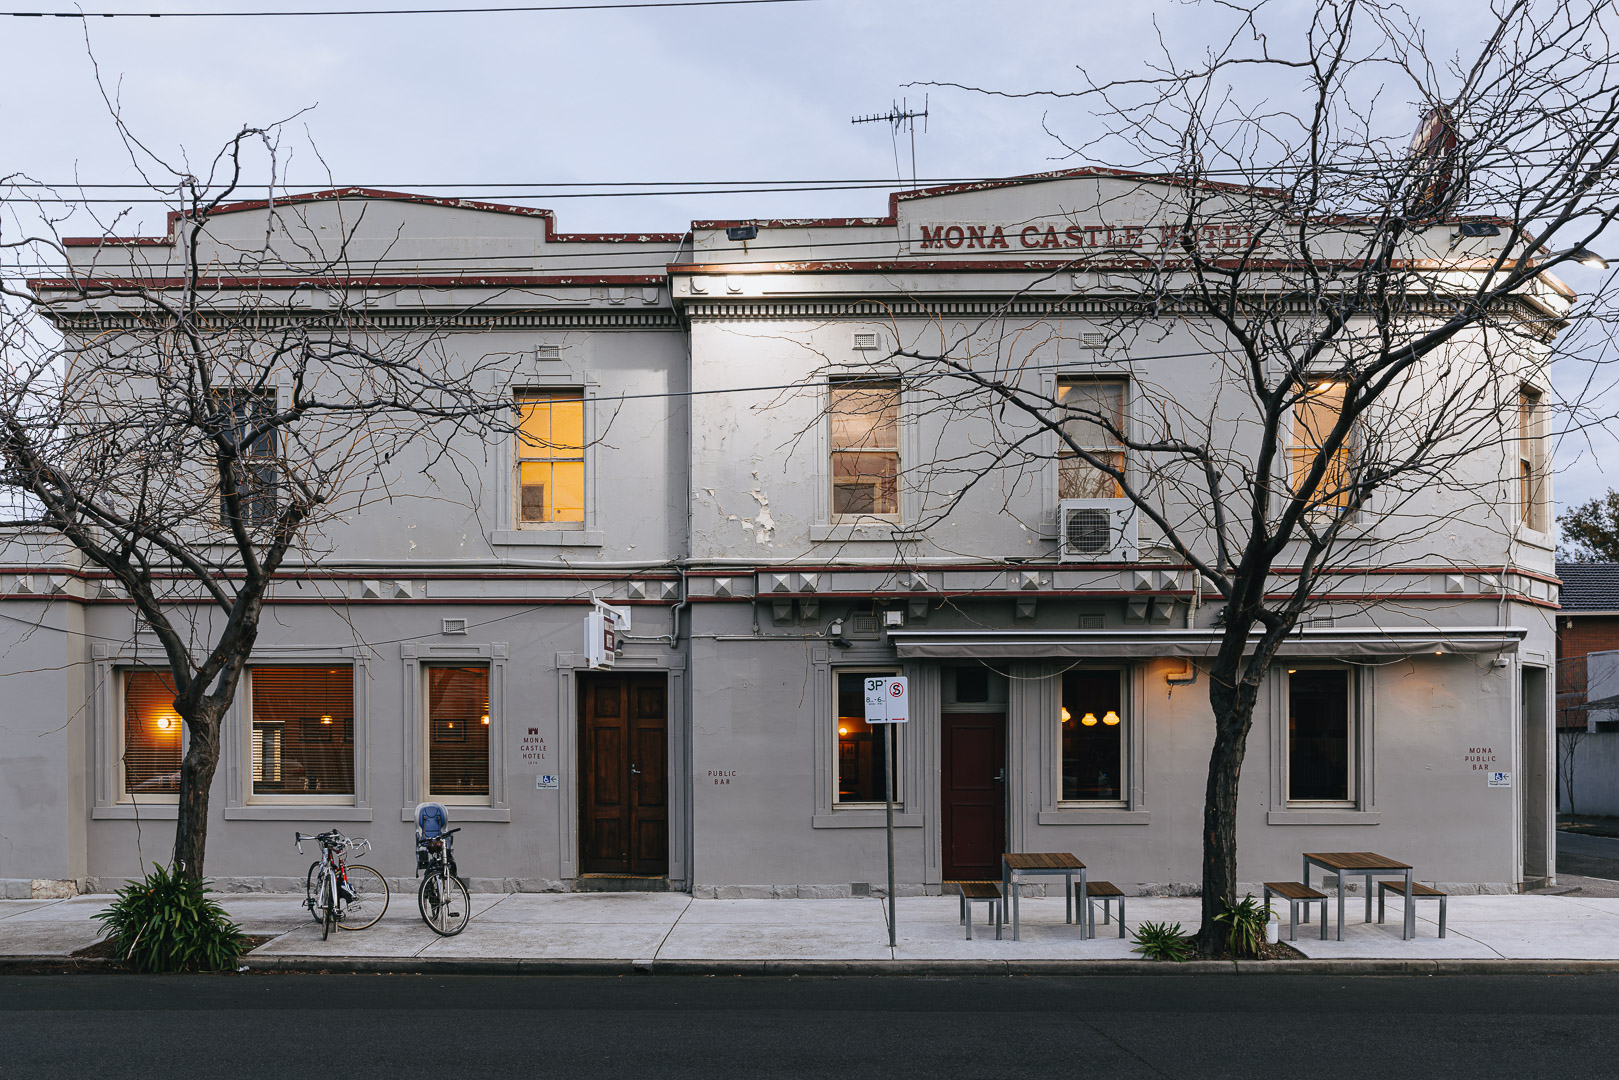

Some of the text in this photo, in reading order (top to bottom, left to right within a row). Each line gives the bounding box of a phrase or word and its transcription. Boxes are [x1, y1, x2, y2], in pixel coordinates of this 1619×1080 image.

[920, 225, 1009, 248] MONA
[1020, 225, 1143, 248] CASTLE
[867, 680, 884, 691] 3P
